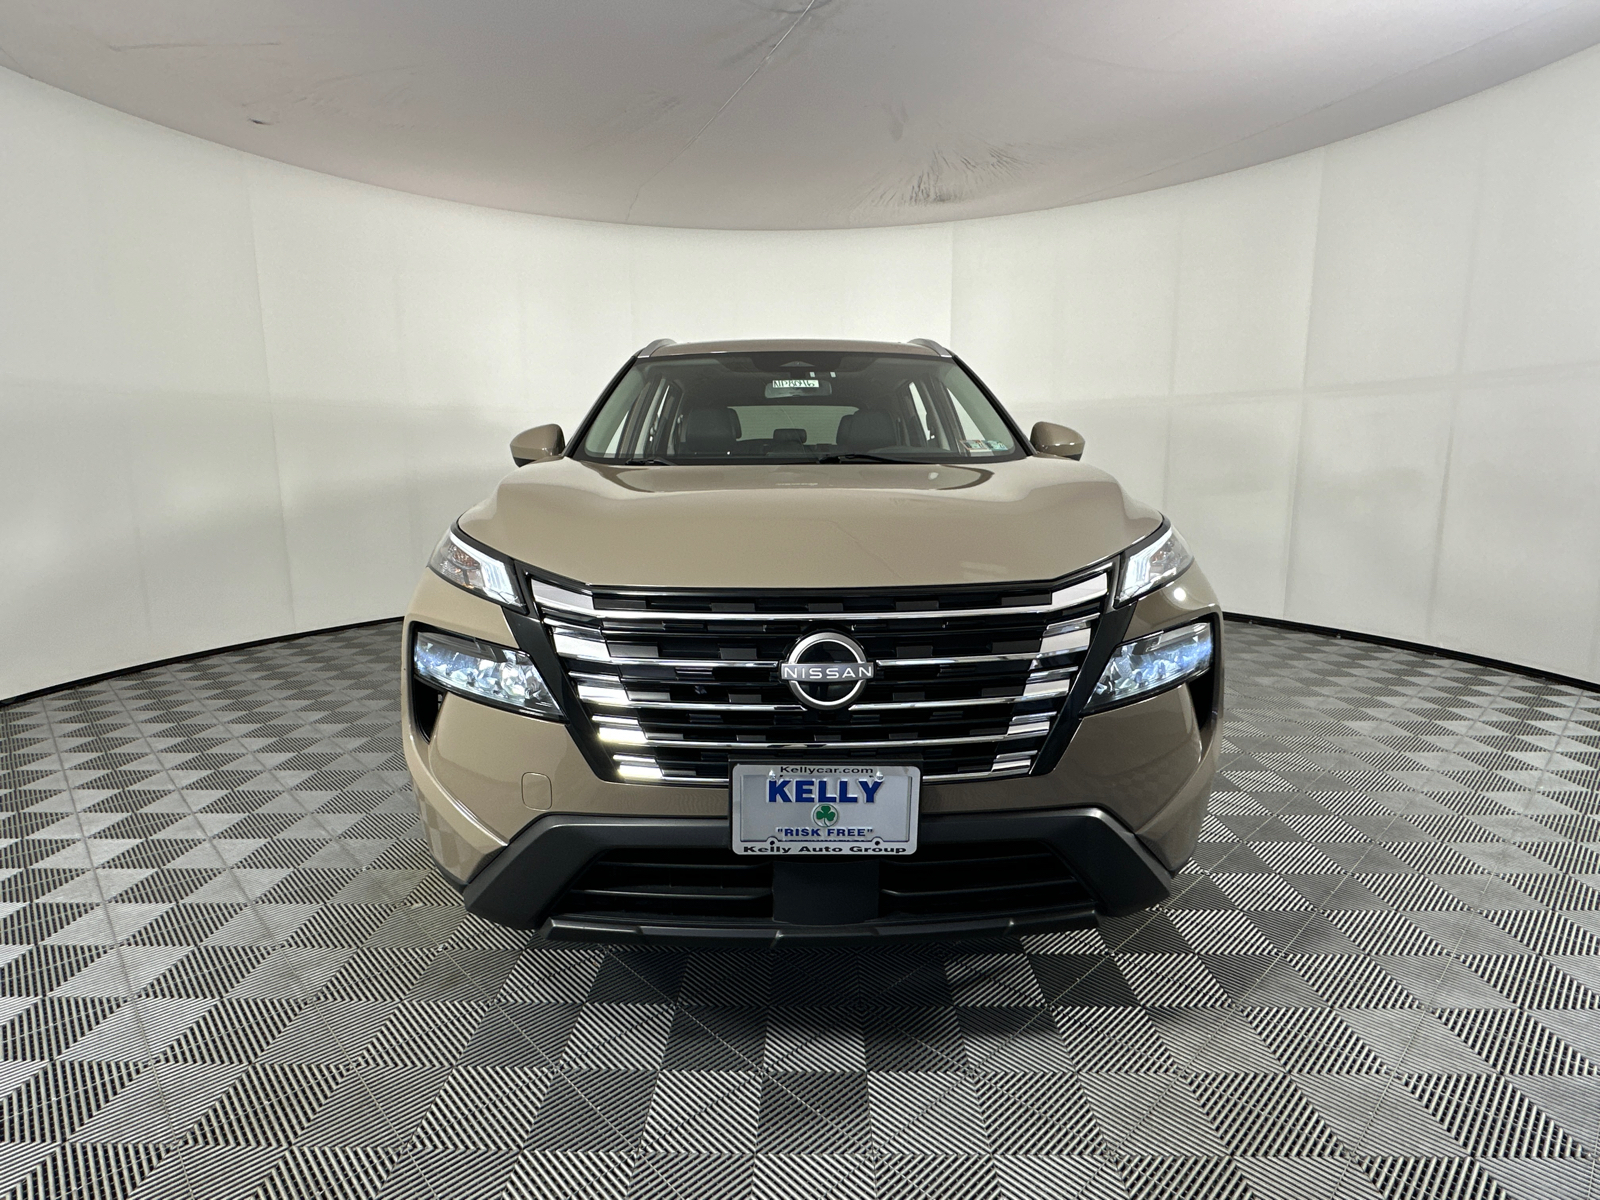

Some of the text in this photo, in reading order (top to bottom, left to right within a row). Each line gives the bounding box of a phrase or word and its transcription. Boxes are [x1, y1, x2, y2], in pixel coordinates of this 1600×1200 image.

[784, 666, 872, 679] NISSAN
[780, 766, 873, 775] Kellycar.com
[767, 779, 884, 803] KELLY
[777, 828, 873, 837] "RISK FREE"
[743, 845, 907, 855] Kelly Auto Group
